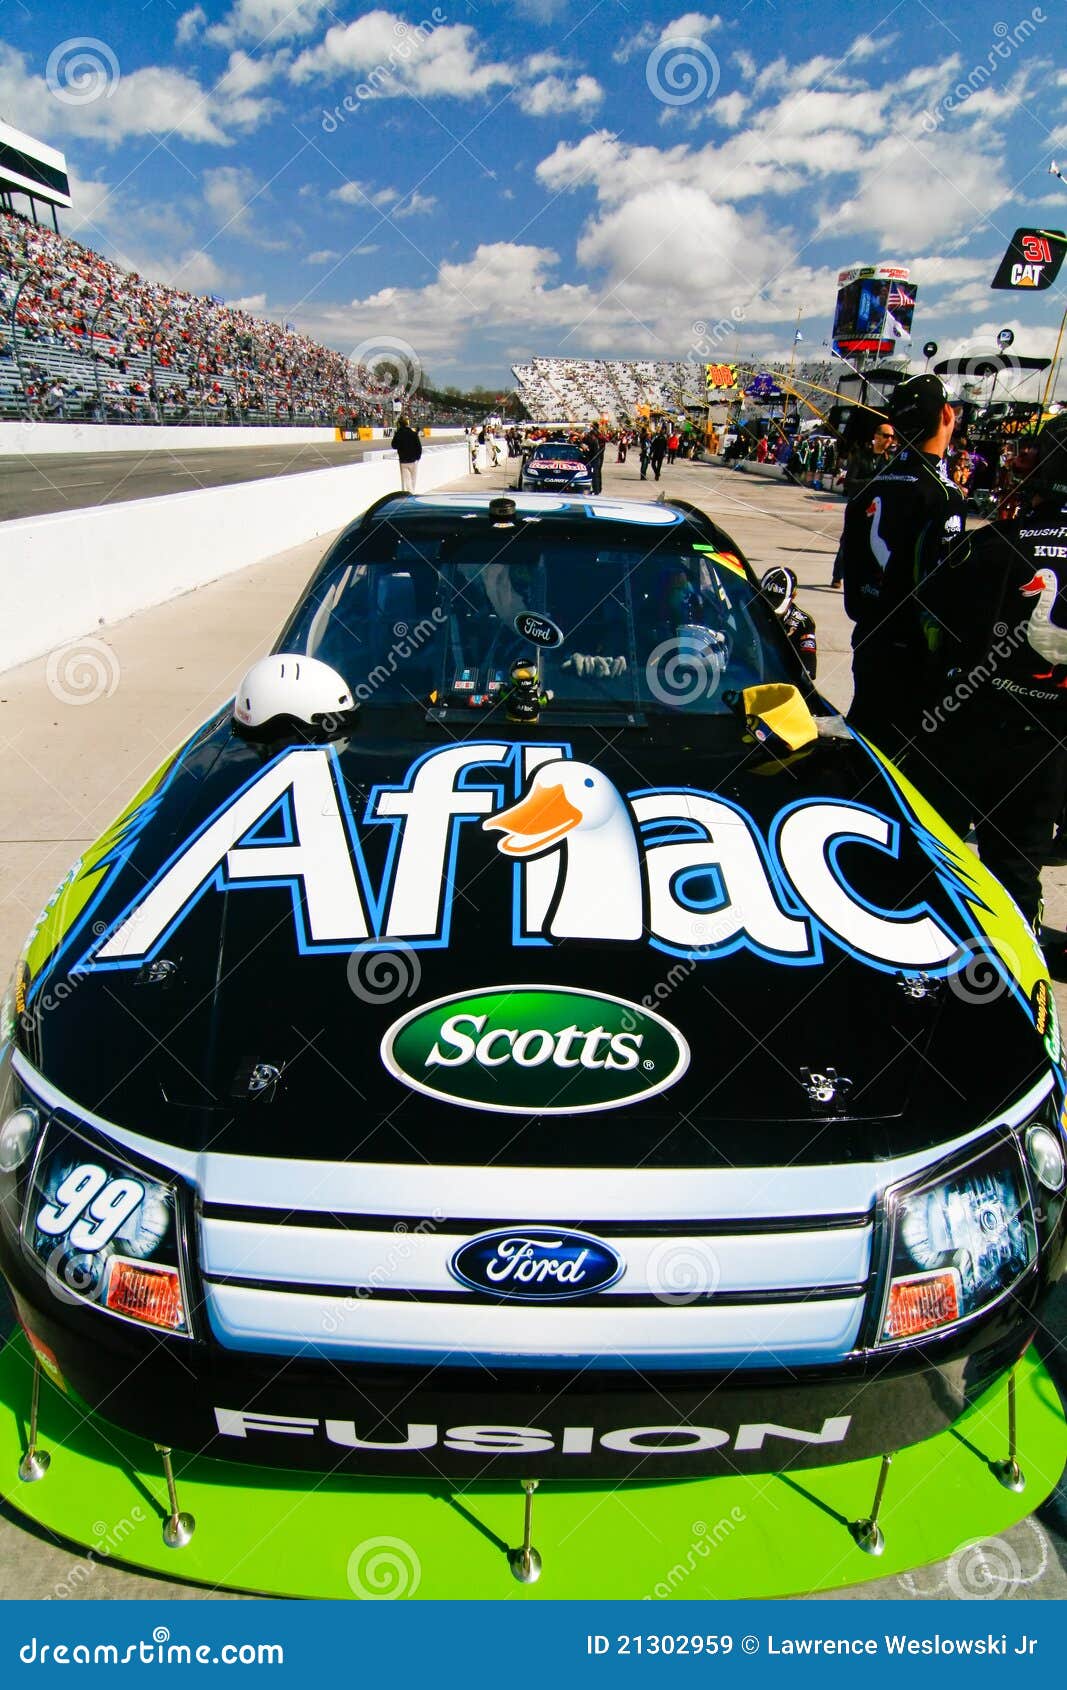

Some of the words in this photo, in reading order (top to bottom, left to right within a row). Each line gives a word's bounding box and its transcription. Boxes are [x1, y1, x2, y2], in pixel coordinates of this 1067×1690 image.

[1021, 236, 1052, 263] 31
[1010, 263, 1045, 287] CAT
[524, 617, 550, 642] Ford
[992, 677, 1059, 701] aflac.com
[84, 742, 962, 970] Aflac
[425, 1014, 644, 1071] Scotts
[36, 1163, 146, 1252] 99
[486, 1237, 590, 1283] Ford
[213, 1406, 852, 1454] FUSION
